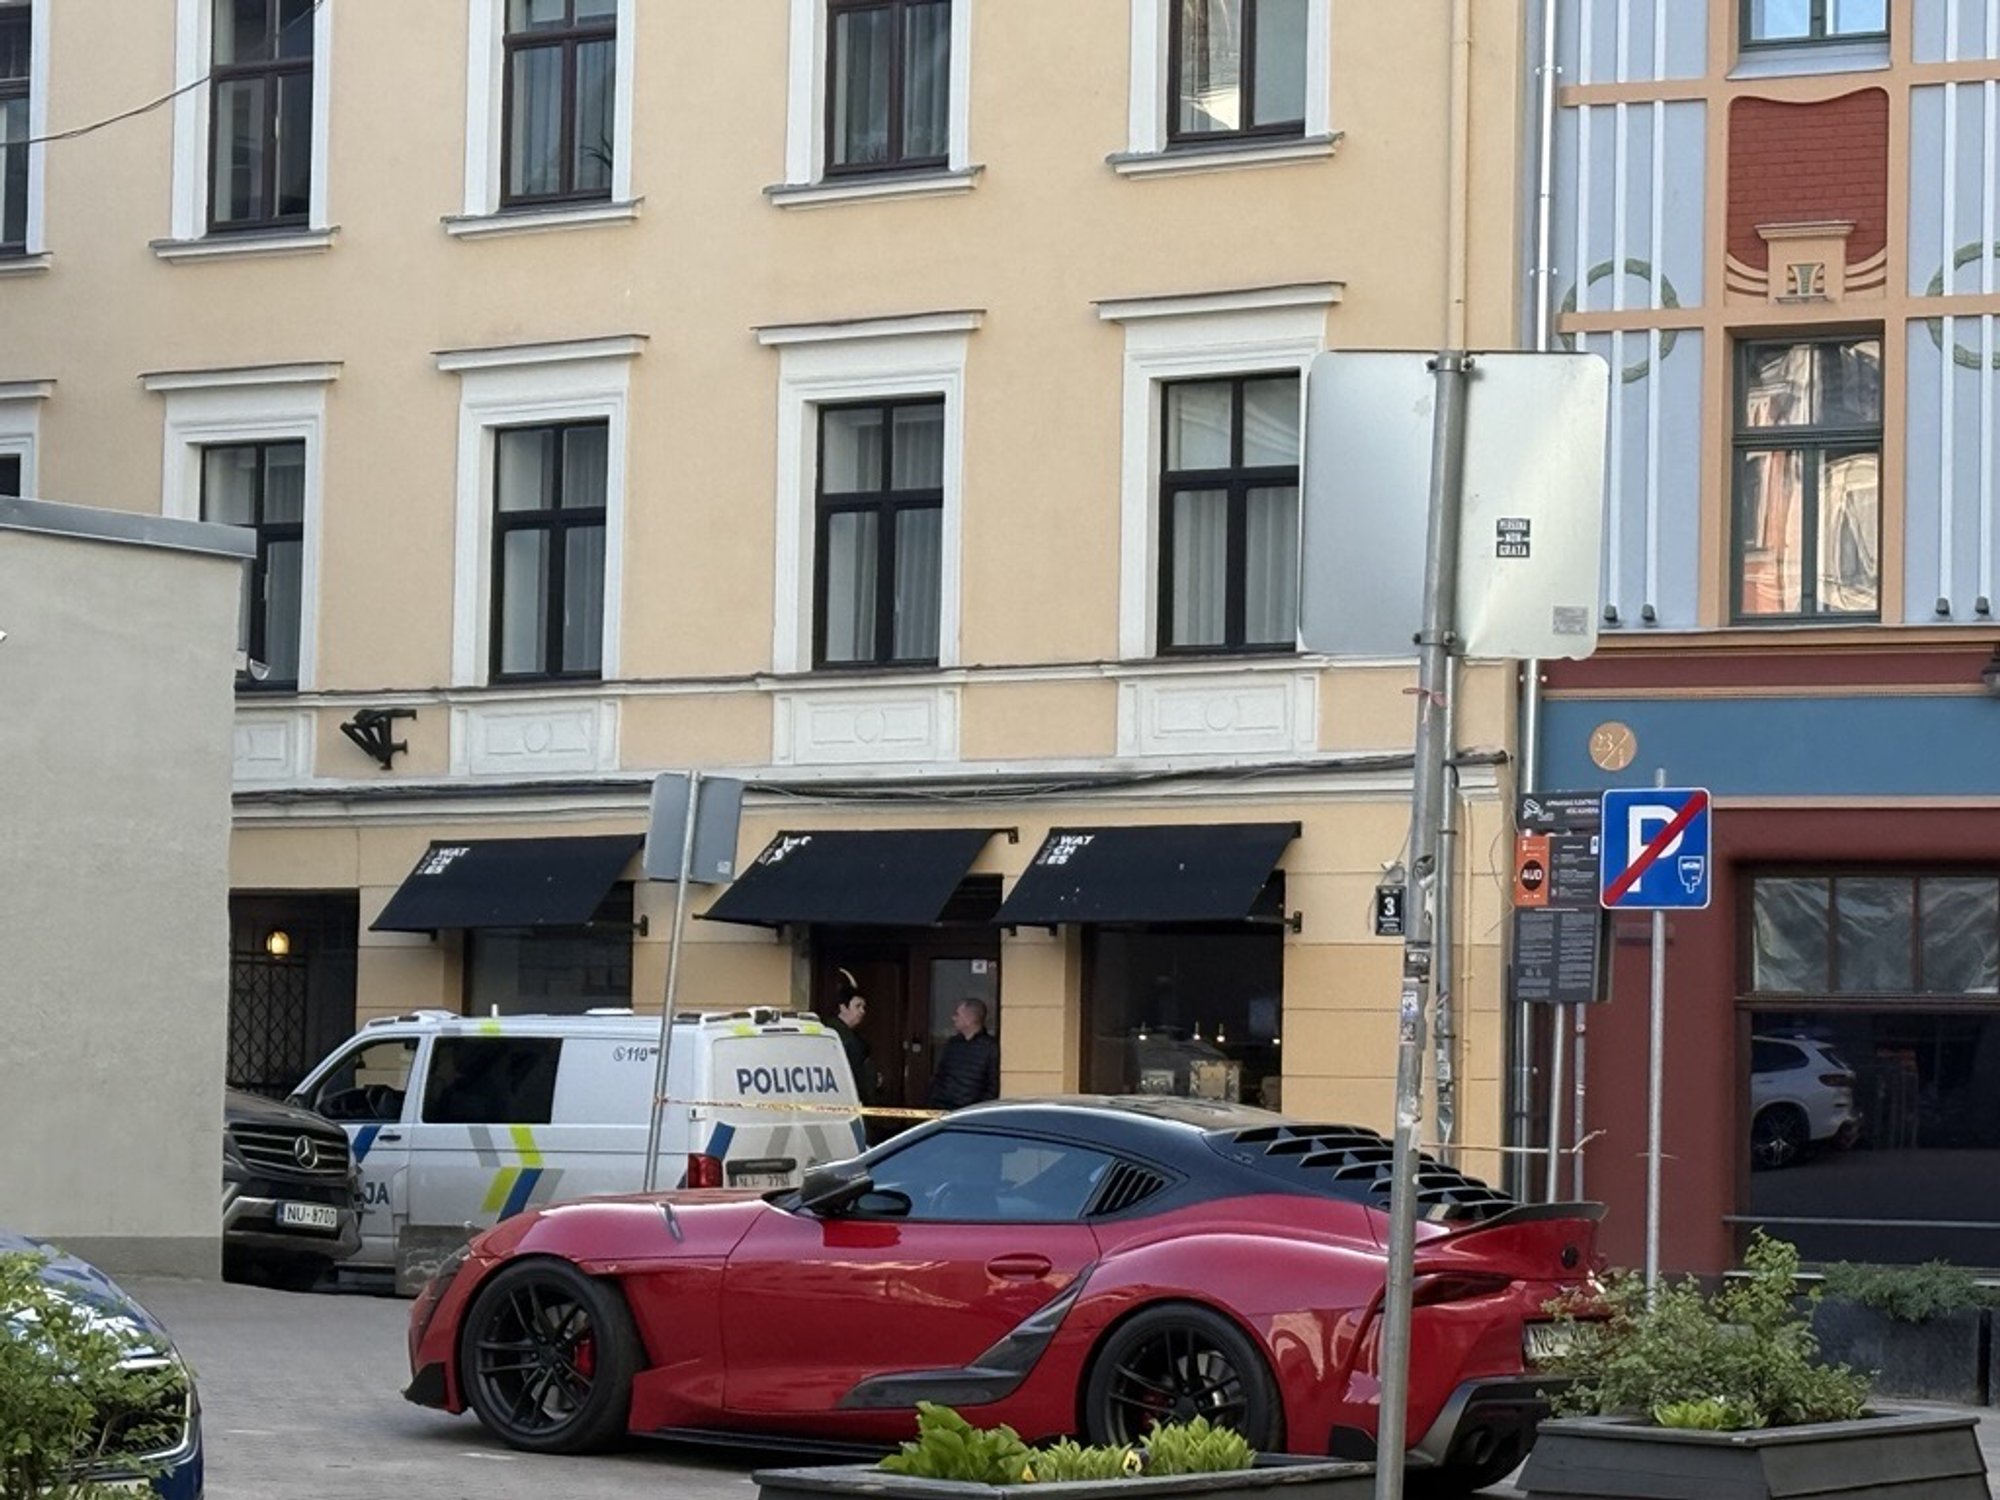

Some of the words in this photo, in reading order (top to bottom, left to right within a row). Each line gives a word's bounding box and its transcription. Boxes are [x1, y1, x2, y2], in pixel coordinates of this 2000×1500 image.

[1060, 834, 1095, 845] WAT
[1627, 805, 1683, 893] P
[1384, 896, 1396, 916] 3
[627, 1046, 648, 1061] 110
[736, 1066, 839, 1095] POLICIJA
